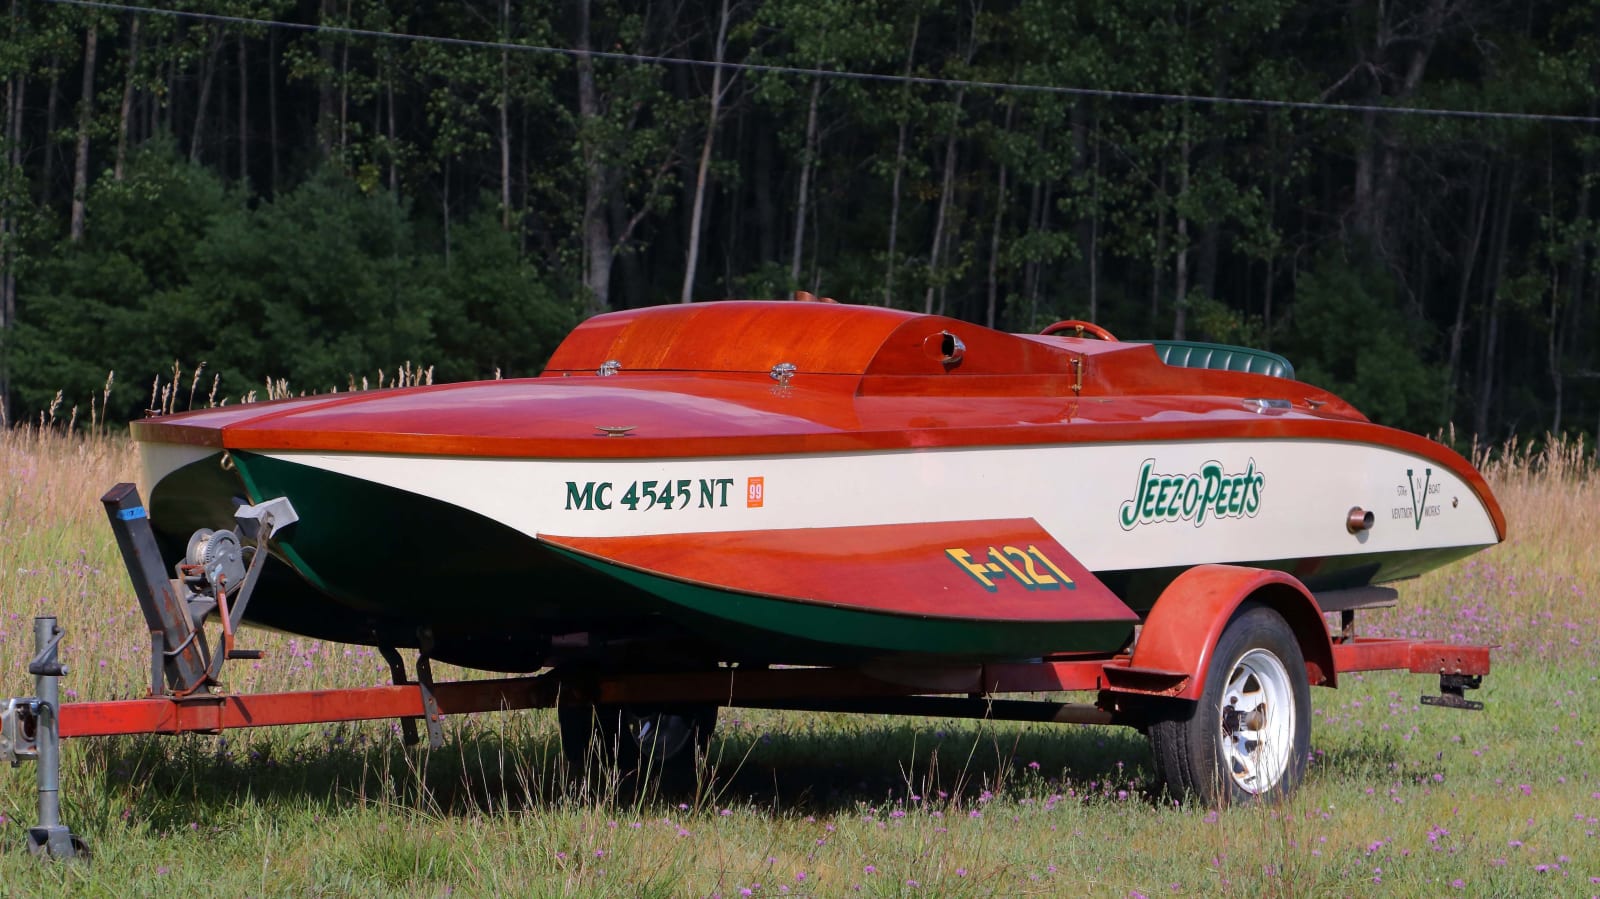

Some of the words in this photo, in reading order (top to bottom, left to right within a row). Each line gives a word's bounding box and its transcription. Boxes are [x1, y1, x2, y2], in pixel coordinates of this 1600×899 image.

[564, 481, 613, 511] MC
[620, 479, 692, 512] 4545
[698, 478, 734, 509] NT
[749, 484, 762, 500] 99
[1428, 483, 1441, 495] BOAT
[1424, 505, 1441, 518] WORKS
[944, 544, 1077, 593] F-121
